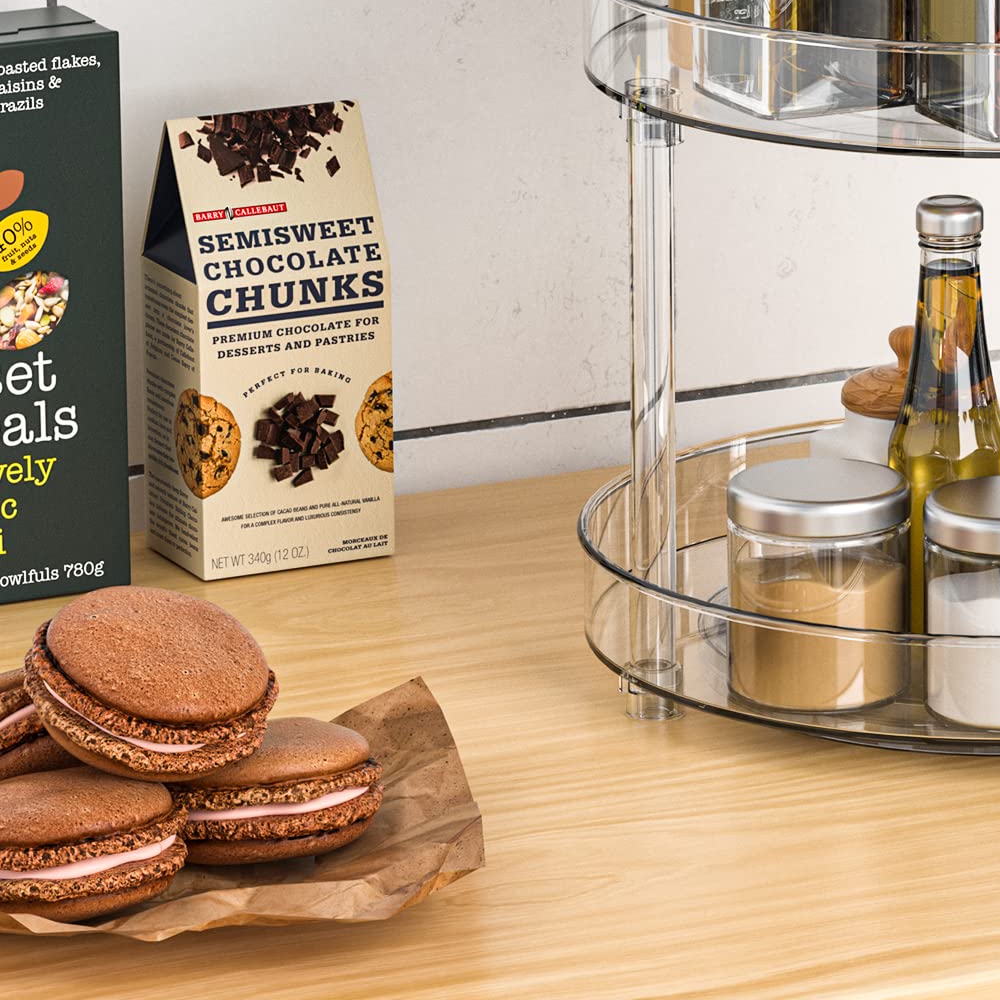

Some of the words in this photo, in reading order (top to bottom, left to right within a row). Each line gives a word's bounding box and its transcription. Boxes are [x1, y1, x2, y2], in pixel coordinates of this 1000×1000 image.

[51, 54, 101, 71] flakes,
[48, 75, 62, 89] &
[195, 210, 224, 222] BARRY
[235, 203, 285, 217] CALLEBAUT
[198, 216, 375, 254] SEMISWEET
[2, 247, 21, 262] fruit,
[20, 233, 37, 248] nuts
[17, 243, 37, 260] seeds
[203, 243, 382, 281] CHOCOLATE
[206, 270, 384, 316] CHUNKS
[212, 329, 273, 345] PREMIUM
[276, 320, 351, 337] CHOCOLATE
[355, 316, 380, 327] FOR
[217, 343, 281, 359] DESSERTS
[285, 339, 312, 351] AND
[315, 331, 375, 347] PASTRIES
[0, 351, 57, 395] et
[242, 370, 286, 398] PERFECT
[290, 366, 310, 375] FOR
[314, 367, 352, 384] BAKING
[2, 400, 79, 447] als
[221, 514, 244, 522] AWESOME
[245, 511, 270, 519] SELECTION
[255, 519, 276, 528] COMPLEX
[277, 516, 294, 525] FLAVOR
[327, 544, 362, 553] CHOCOLAT
[342, 535, 378, 545] MORCEAUX
[63, 561, 105, 578] 780g
[211, 557, 229, 570] NET
[230, 554, 247, 569] WT
[247, 551, 272, 567] 340g
[274, 548, 289, 565] (12
